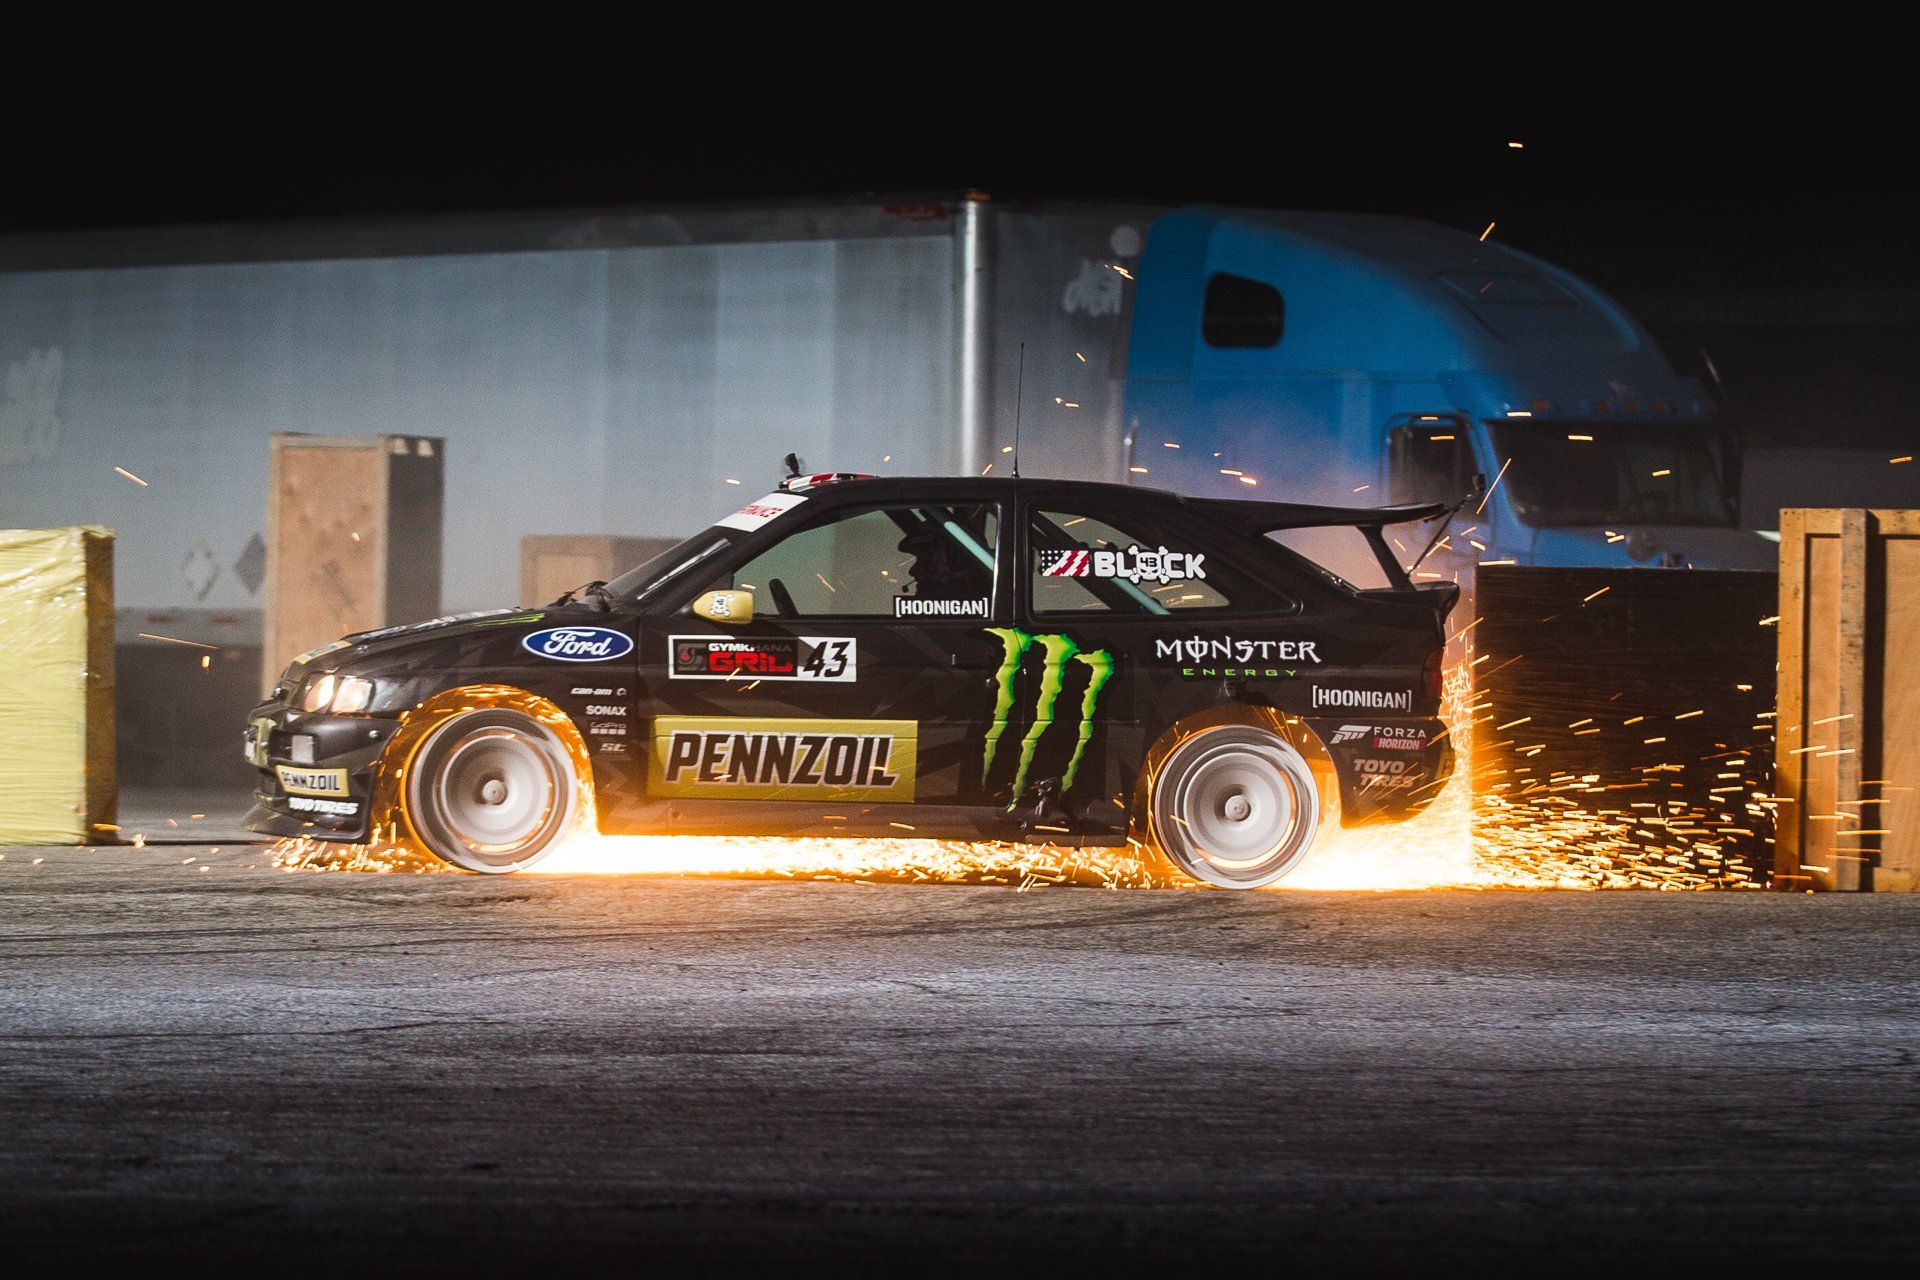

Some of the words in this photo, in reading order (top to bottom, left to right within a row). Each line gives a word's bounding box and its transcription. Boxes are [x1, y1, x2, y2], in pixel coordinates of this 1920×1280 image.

[543, 630, 613, 656] Ford
[1155, 636, 1321, 663] MONSTER
[803, 641, 850, 677] 43
[1183, 668, 1297, 677] ENERGY
[586, 705, 627, 715] SONAX
[1374, 727, 1427, 738] FORZA
[1378, 738, 1420, 750] HORIZON
[664, 731, 899, 786] PENNZOIL
[1354, 759, 1405, 773] TOYO
[1360, 774, 1414, 788] TIRES
